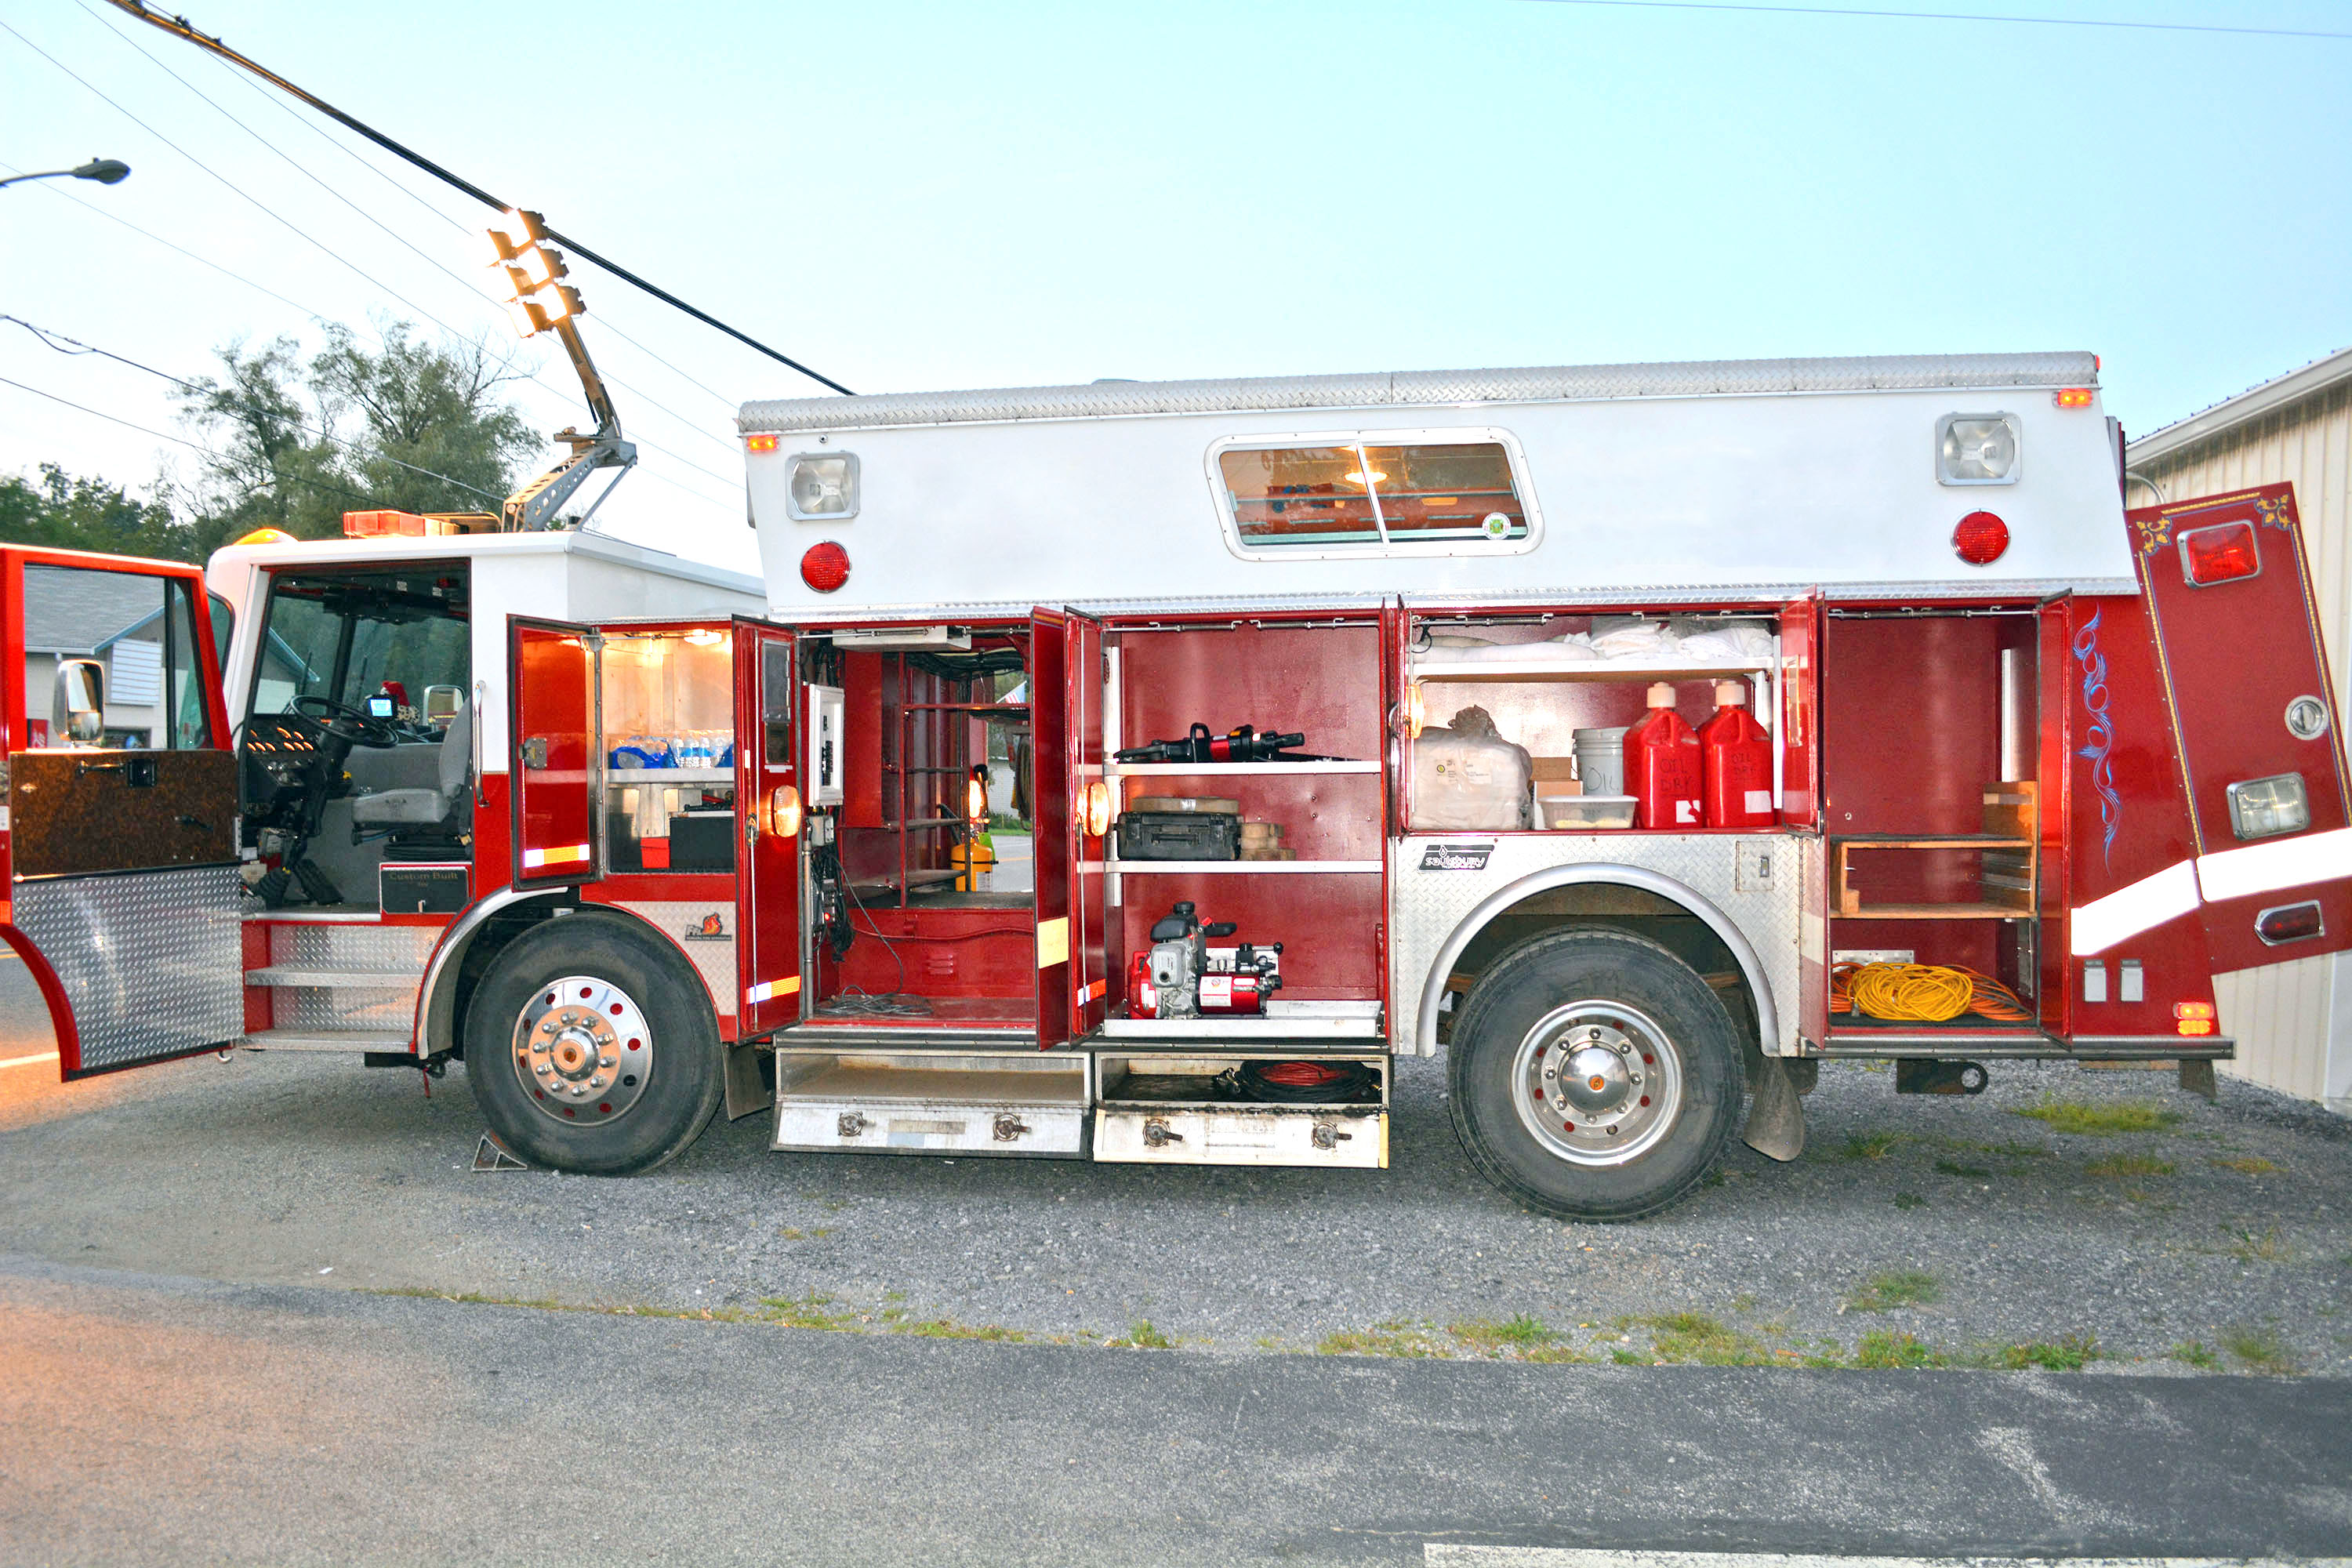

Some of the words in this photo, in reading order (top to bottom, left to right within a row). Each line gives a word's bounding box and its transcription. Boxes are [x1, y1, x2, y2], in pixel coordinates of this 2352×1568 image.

[1660, 758, 1687, 774] OIL
[1661, 776, 1693, 791] DRY
[389, 871, 430, 880] Custom
[433, 871, 459, 880] Built
